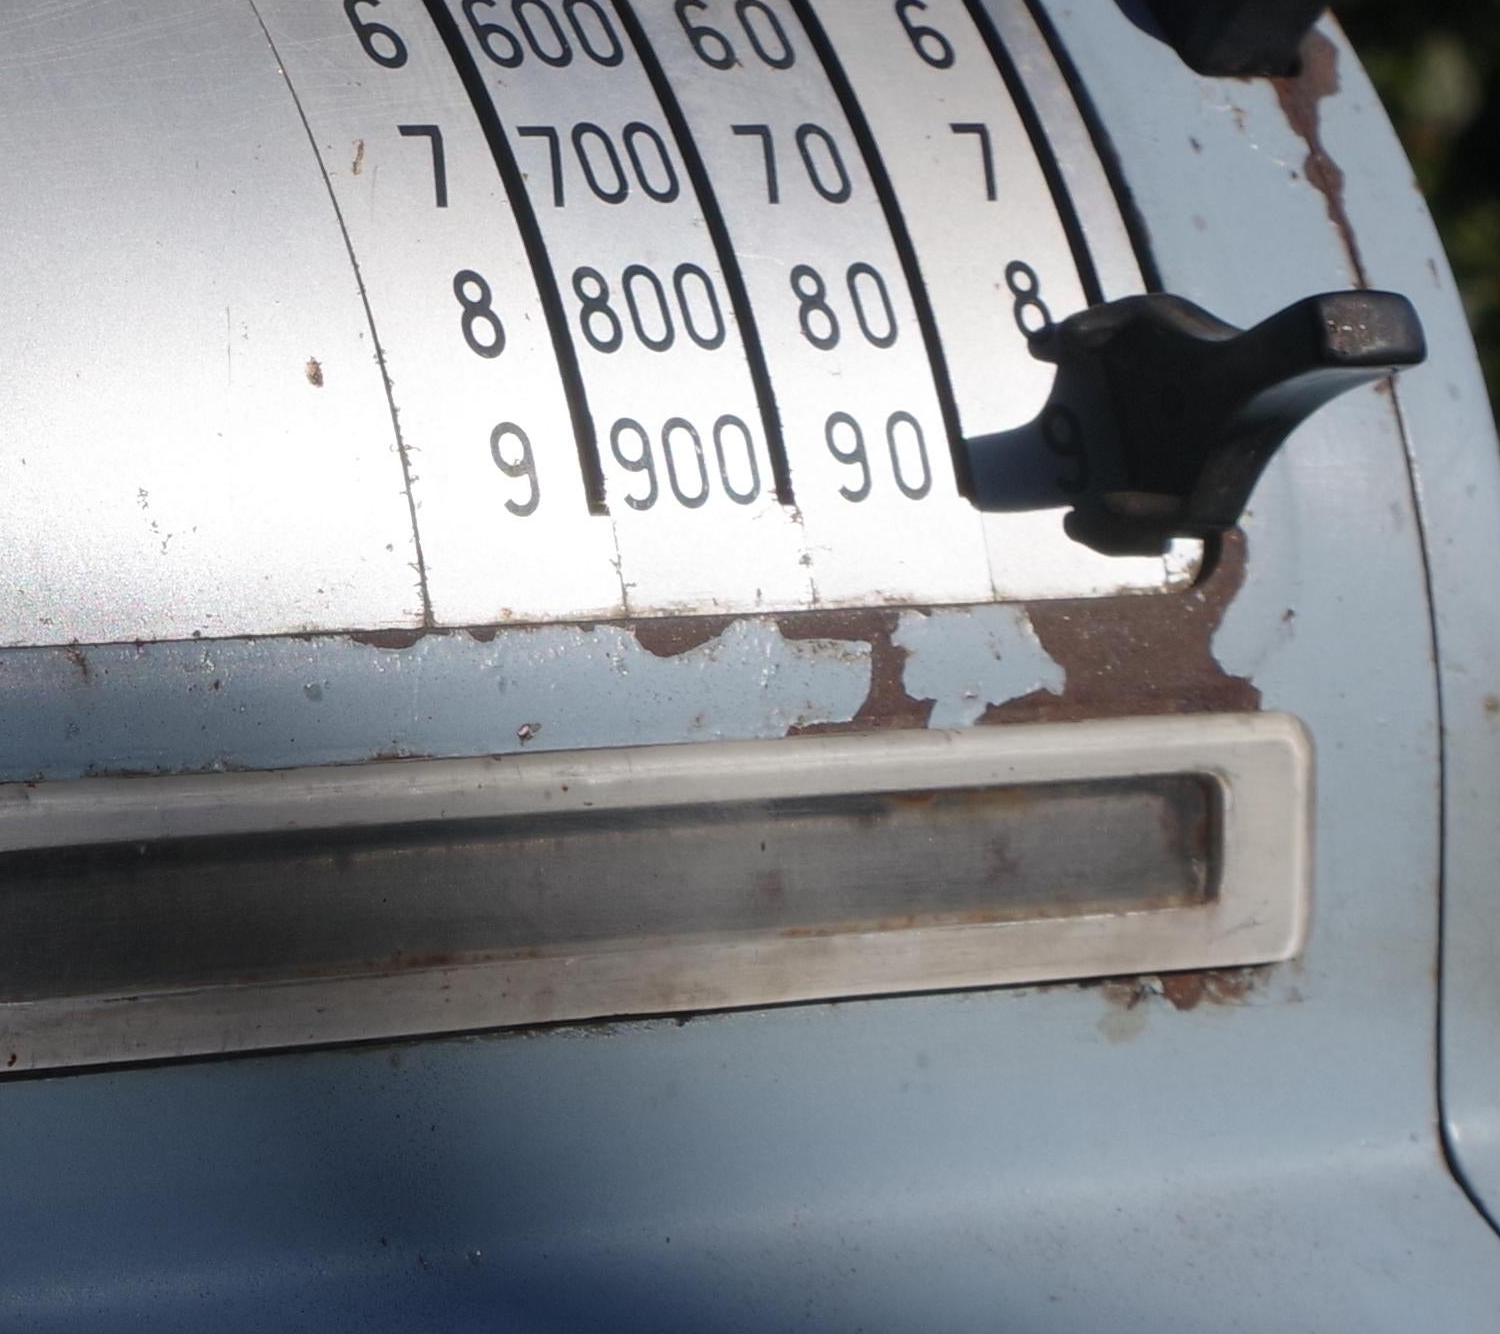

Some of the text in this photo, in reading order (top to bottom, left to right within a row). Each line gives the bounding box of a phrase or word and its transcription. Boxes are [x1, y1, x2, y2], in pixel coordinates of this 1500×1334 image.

[399, 121, 998, 208] 7 700 70 7
[453, 260, 1052, 359] 8 800 80 8
[490, 421, 541, 516] 9
[610, 414, 763, 511] 900
[824, 410, 933, 502] 90
